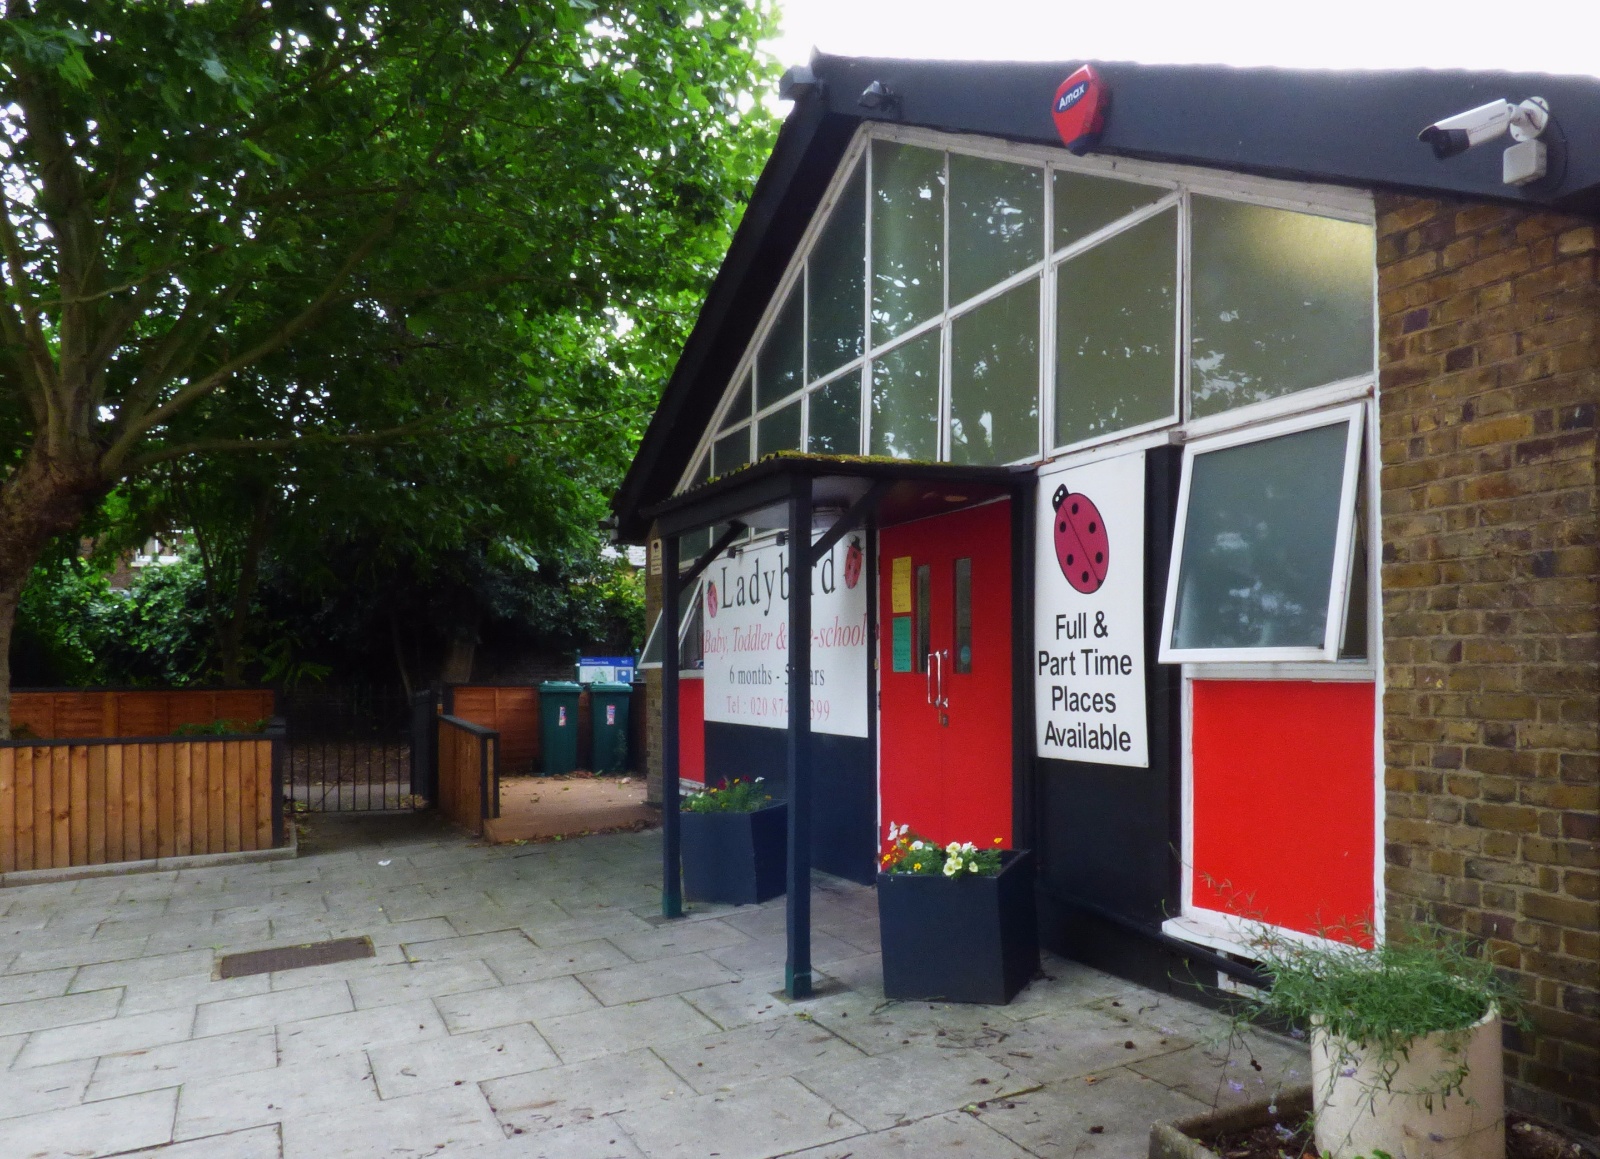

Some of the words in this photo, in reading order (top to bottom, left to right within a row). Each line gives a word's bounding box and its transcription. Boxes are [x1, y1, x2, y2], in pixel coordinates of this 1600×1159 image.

[1058, 84, 1085, 110] Amax
[721, 546, 836, 616] Ladybrd
[733, 624, 773, 652] Toddler
[776, 622, 786, 650] &
[1055, 612, 1087, 640] Full
[1093, 610, 1108, 638] &
[729, 668, 735, 684] 6
[737, 665, 772, 685] months
[1038, 650, 1076, 676] Part
[1081, 649, 1132, 676] Time
[751, 697, 768, 716] 020
[1051, 685, 1117, 713] Places
[1044, 720, 1132, 751] Available
